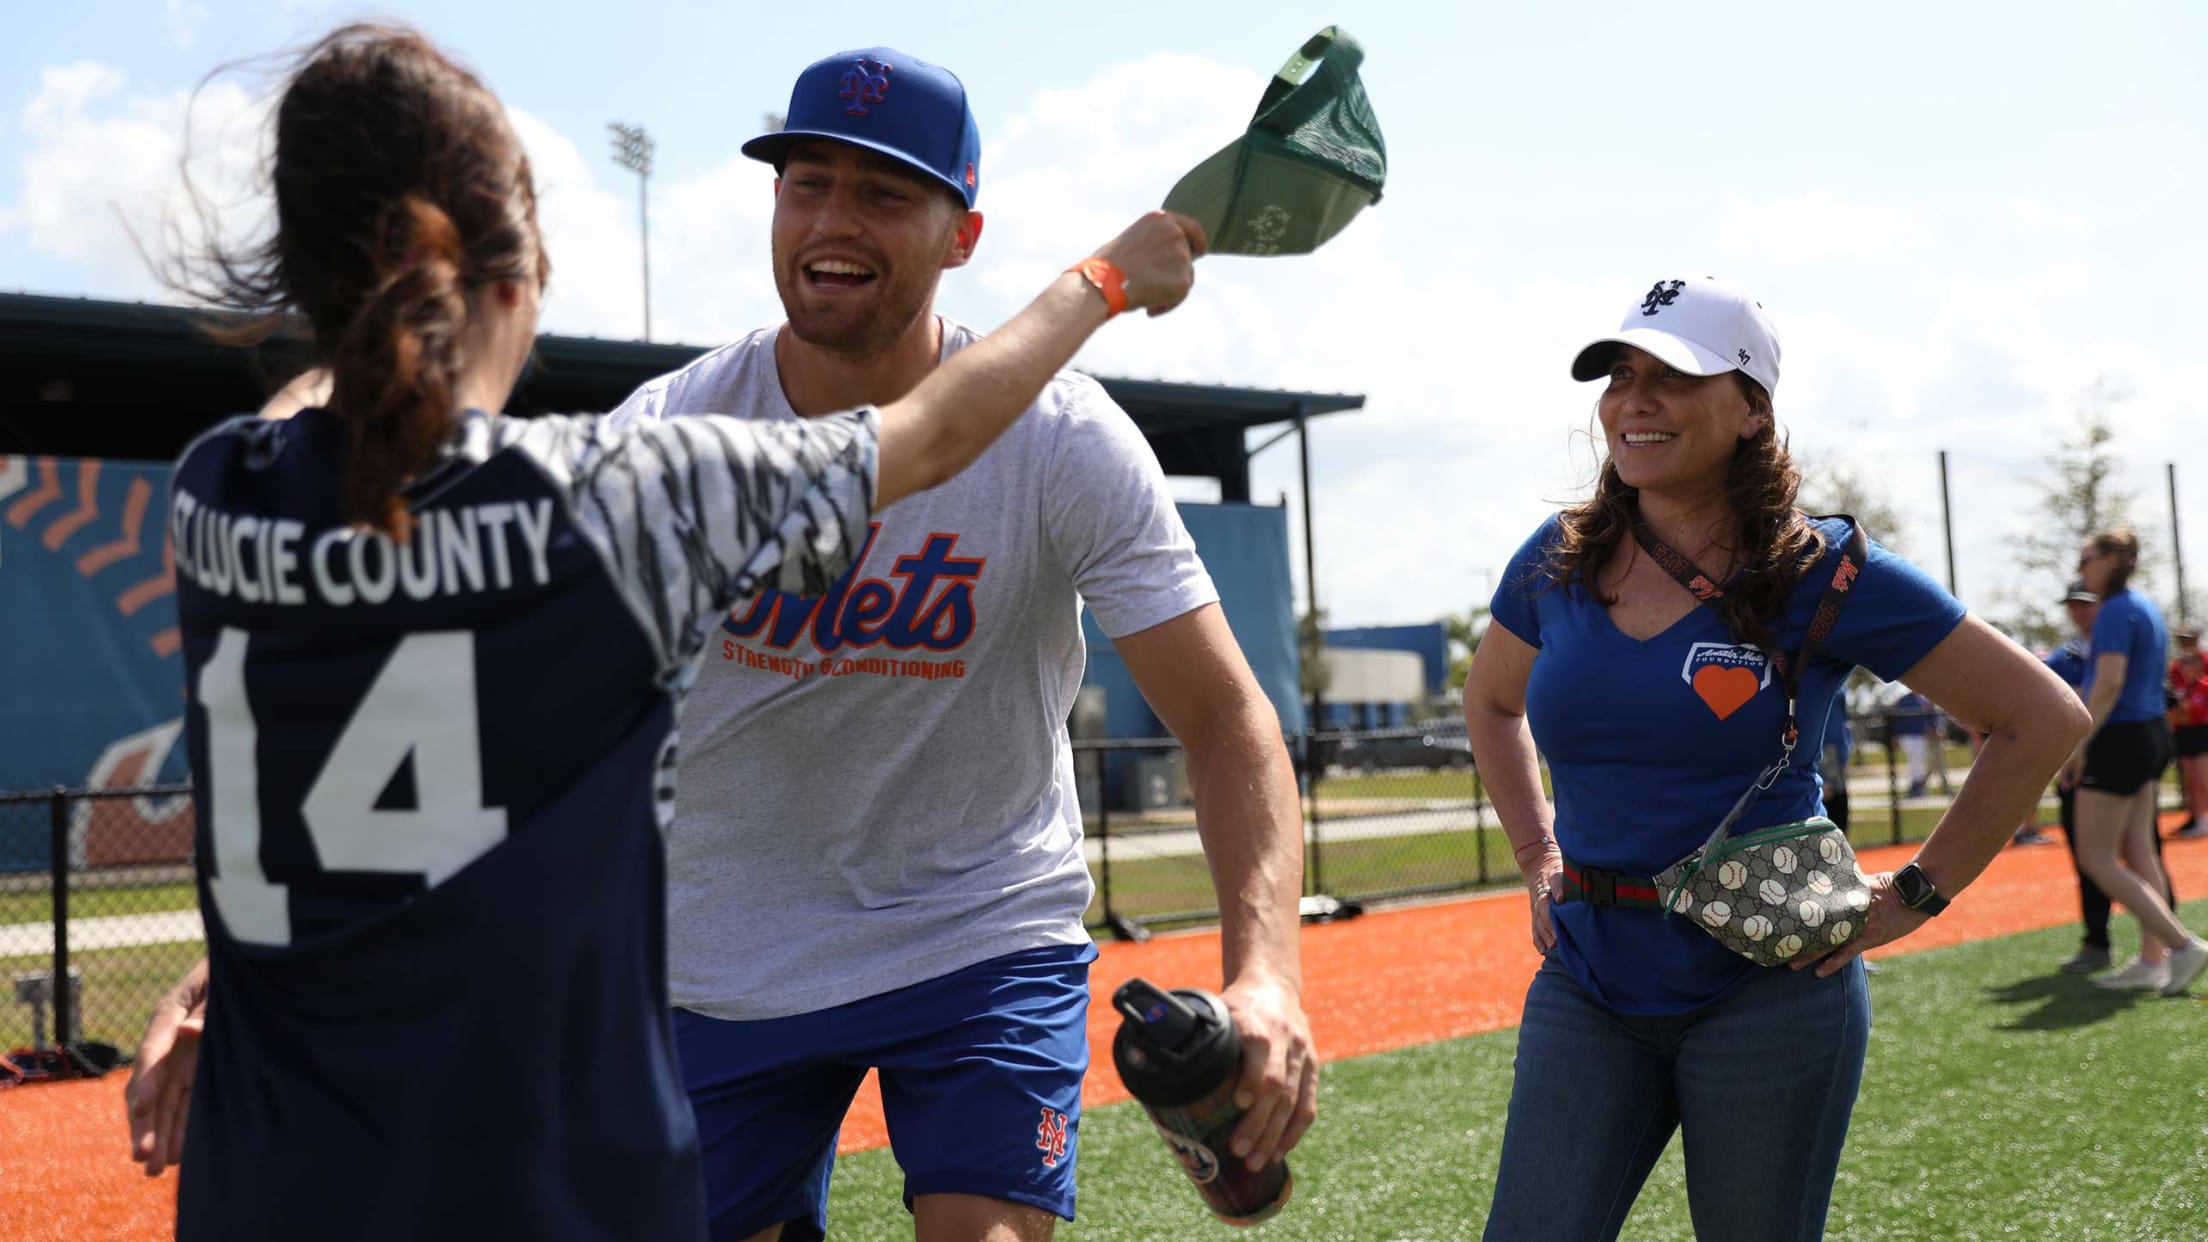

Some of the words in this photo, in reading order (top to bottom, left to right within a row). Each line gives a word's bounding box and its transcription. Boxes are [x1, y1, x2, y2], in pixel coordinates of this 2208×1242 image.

[195, 507, 307, 605] LUCIE
[312, 499, 554, 606] COUNTY
[723, 640, 815, 680] STRENGTH
[831, 656, 967, 680] CONDITIONING
[1695, 656, 1763, 667] FOUNDATION
[199, 625, 509, 948] 14
[1036, 1107, 1068, 1167] NY
